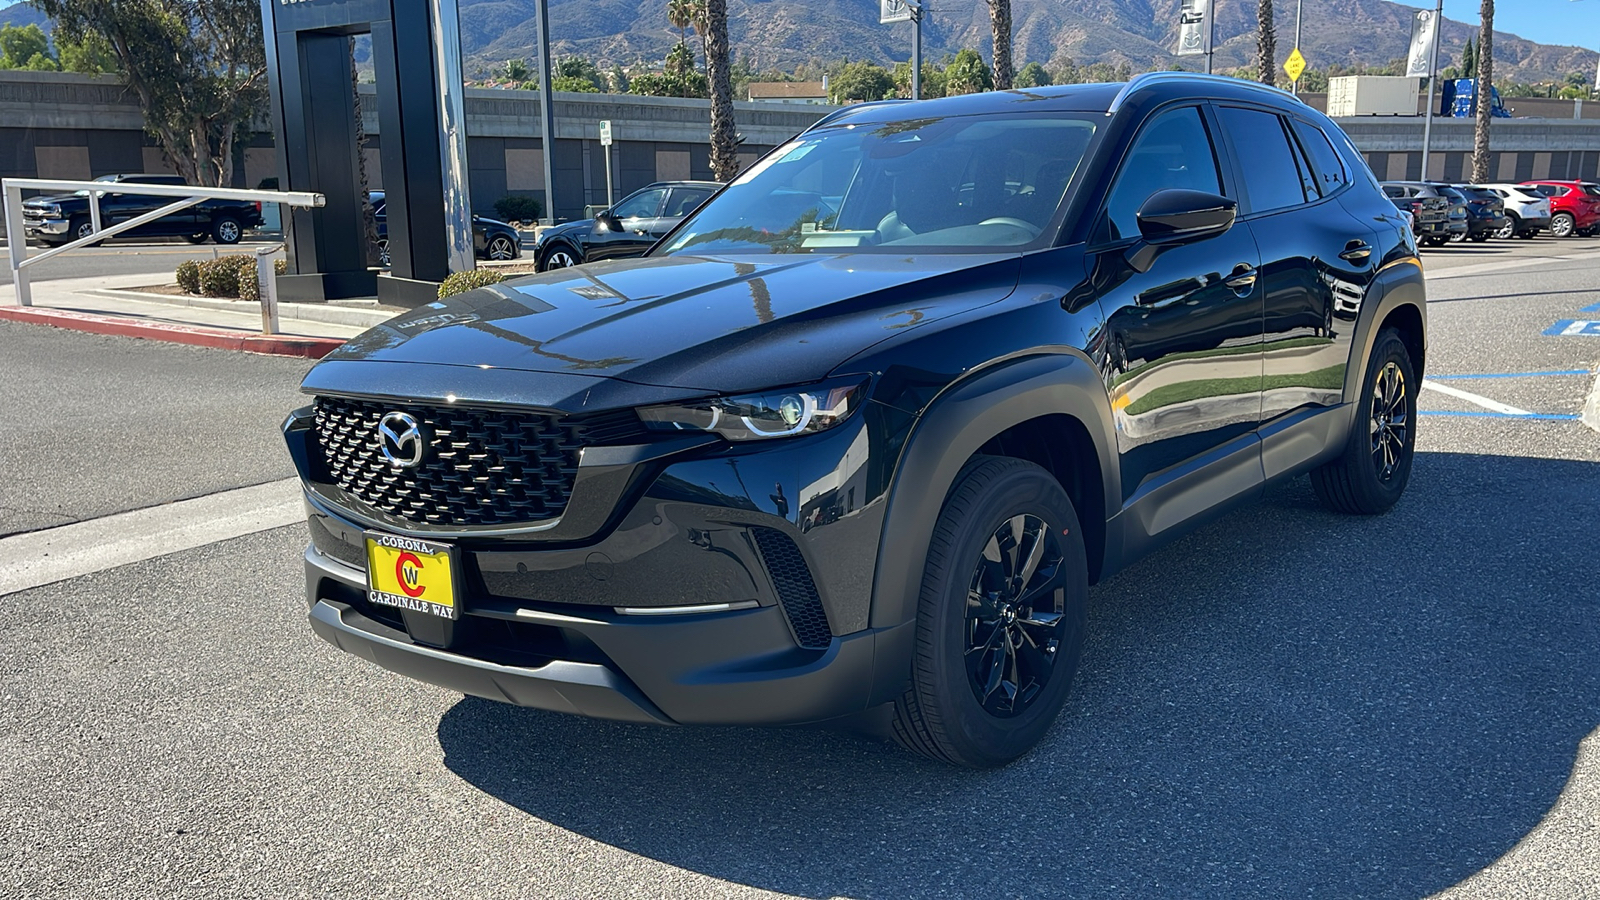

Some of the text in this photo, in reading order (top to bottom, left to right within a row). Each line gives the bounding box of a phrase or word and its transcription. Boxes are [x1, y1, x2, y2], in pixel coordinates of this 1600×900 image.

[382, 536, 429, 553] CORONA
[404, 567, 418, 585] W
[370, 592, 454, 619] CARDINALE WAY
